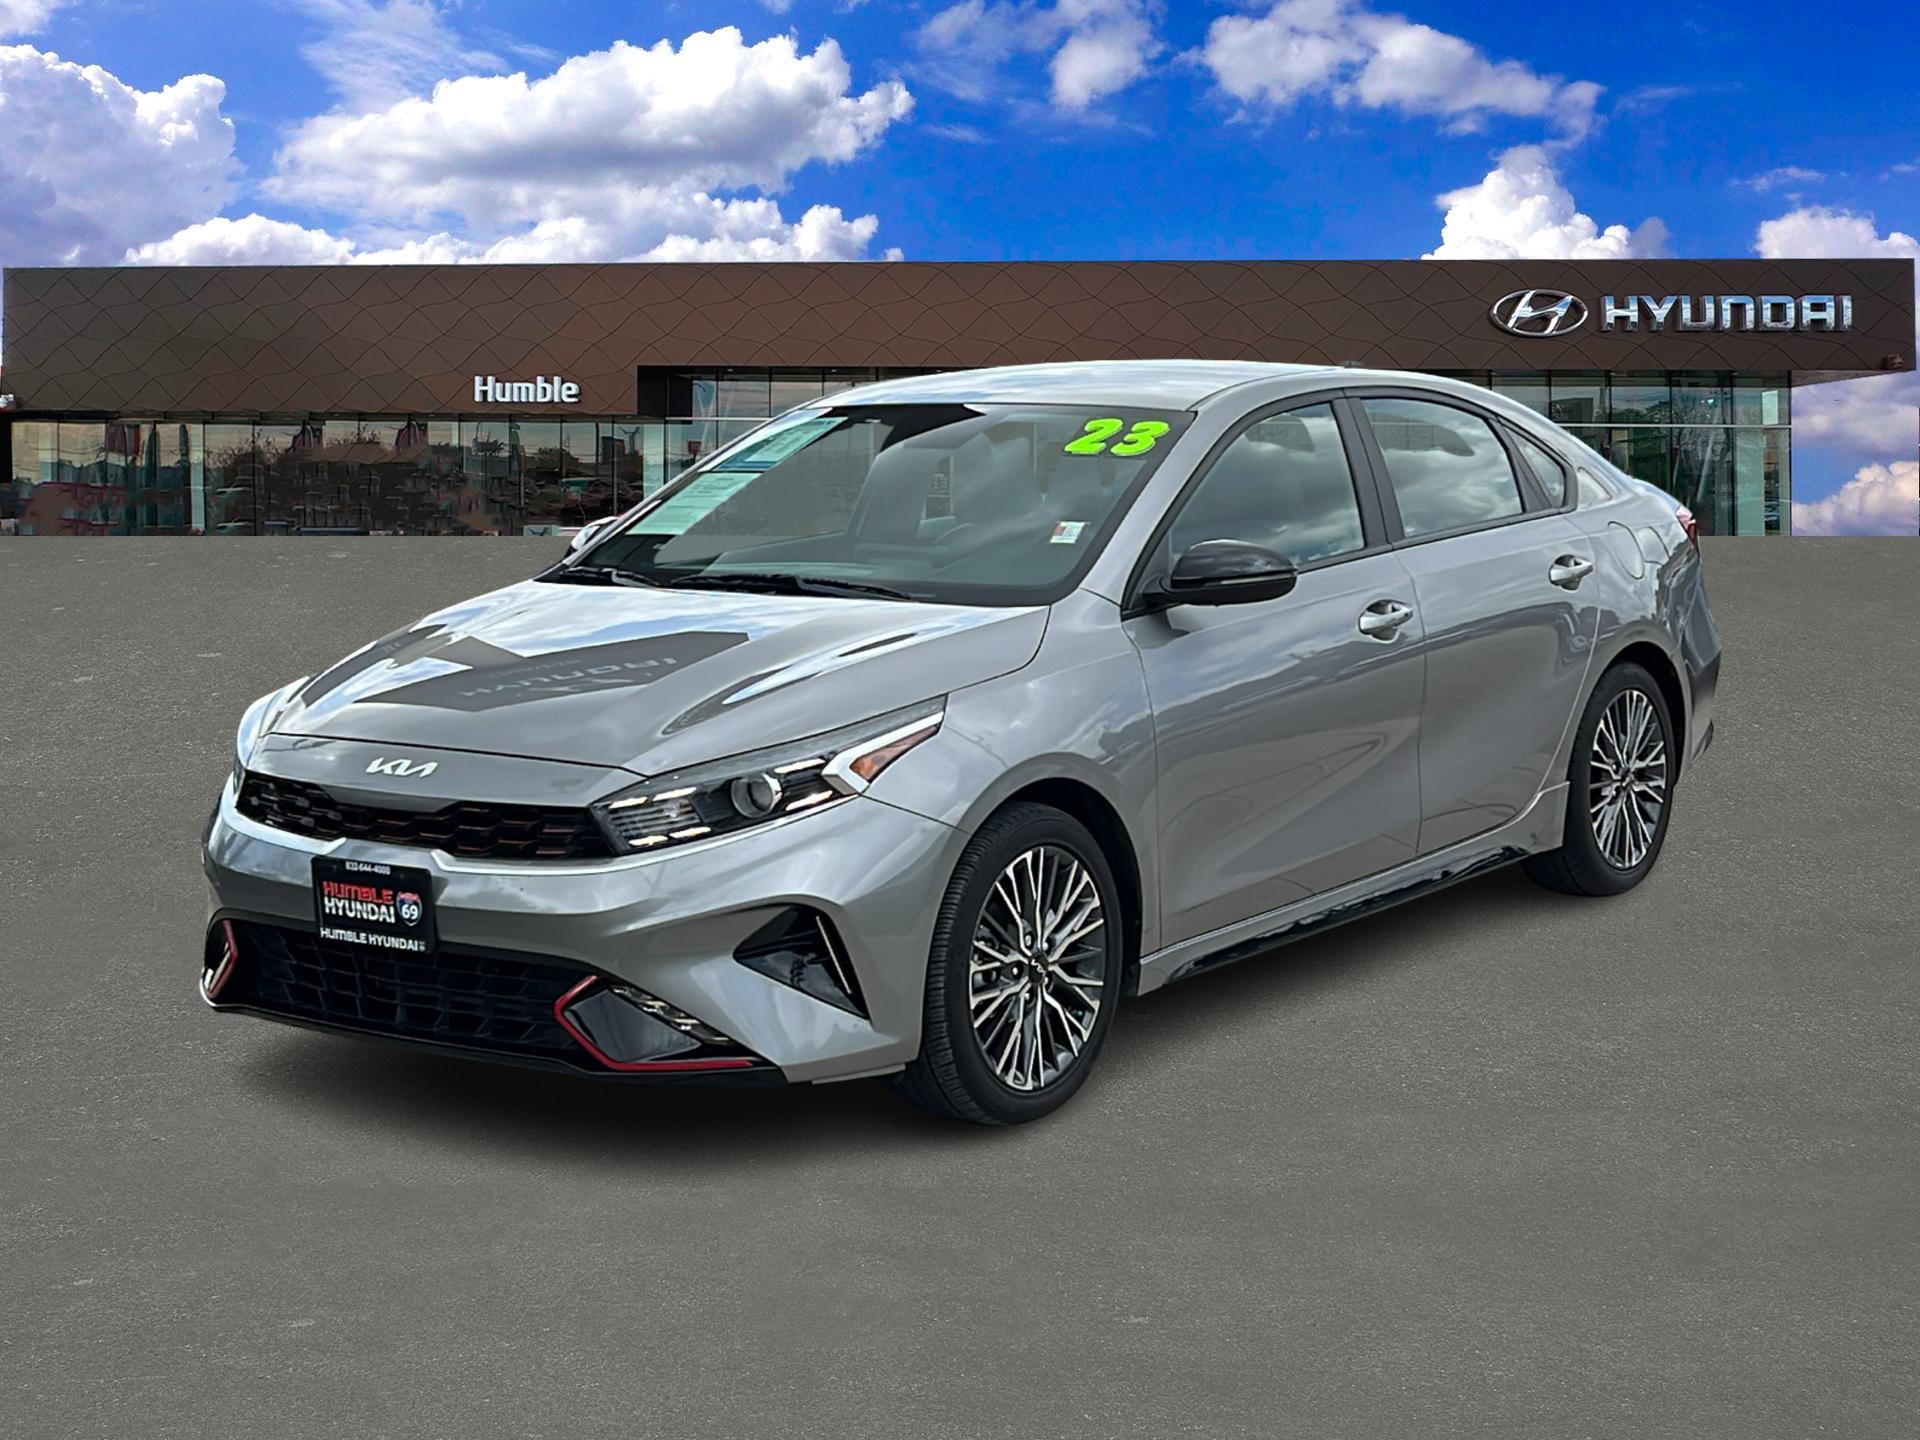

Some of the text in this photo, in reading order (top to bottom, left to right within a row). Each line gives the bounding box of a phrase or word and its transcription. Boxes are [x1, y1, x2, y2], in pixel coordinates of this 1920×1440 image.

[1602, 295, 1852, 332] HYUNDAI
[474, 375, 580, 403] Humble
[1063, 417, 1171, 457] 23
[365, 756, 439, 778] KIA
[322, 881, 395, 905] HUMBLE
[323, 896, 396, 924] HYUNDAI
[401, 904, 419, 920] 69
[320, 927, 368, 944] HUMBLE
[368, 934, 418, 952] HYUNDAI
